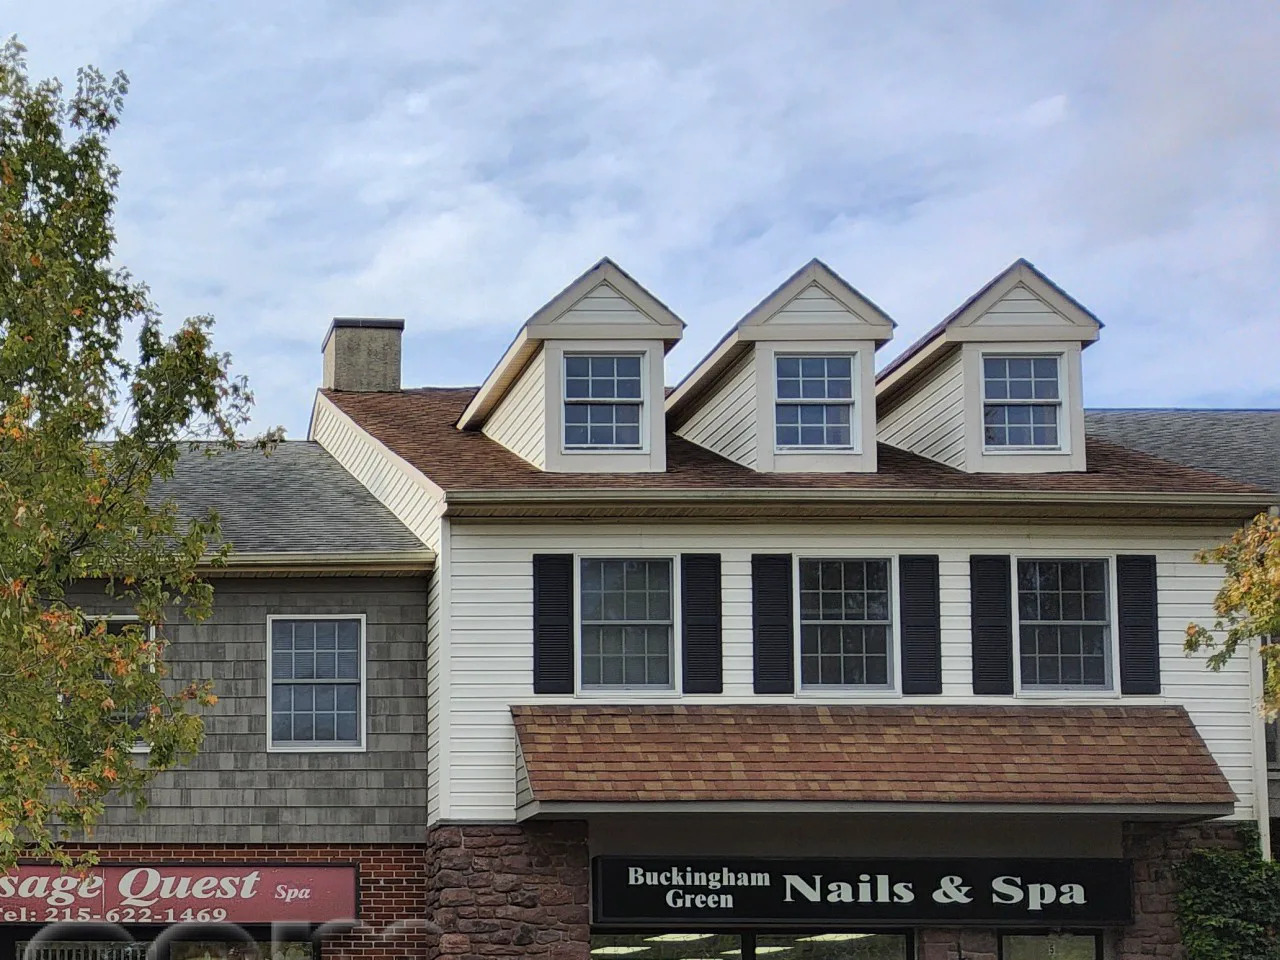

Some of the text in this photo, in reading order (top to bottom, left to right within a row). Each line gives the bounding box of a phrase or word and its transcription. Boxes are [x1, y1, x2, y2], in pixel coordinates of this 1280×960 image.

[118, 867, 260, 907] Quest
[274, 884, 311, 902] Spa
[628, 867, 771, 889] Buckingham
[665, 889, 734, 908] Green
[782, 874, 1088, 911] Nails & Spa
[44, 907, 227, 923] 215-622-1469
